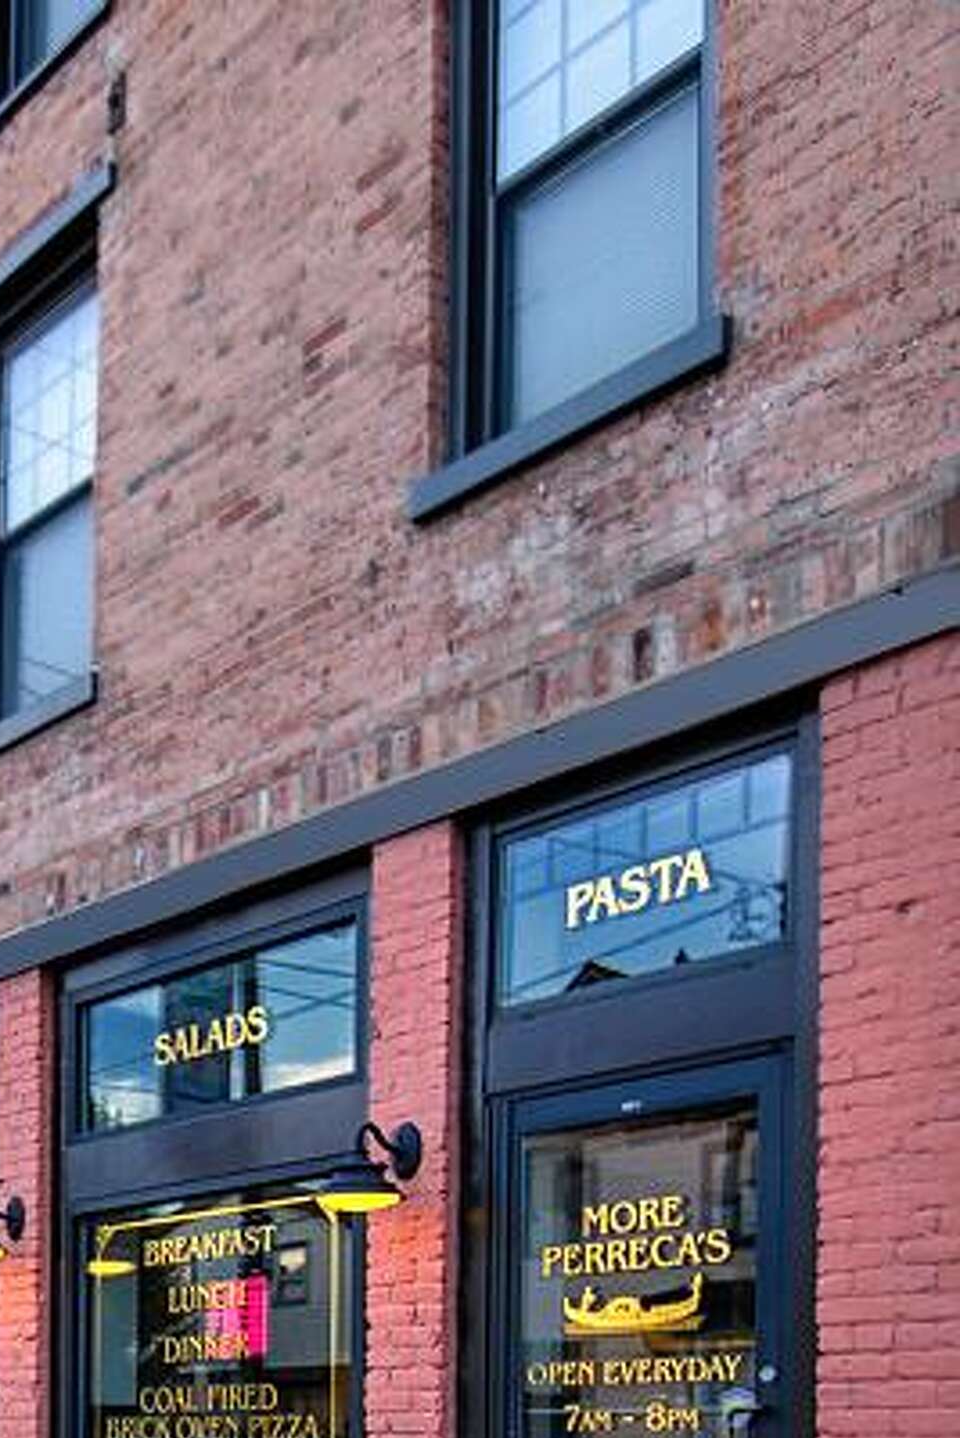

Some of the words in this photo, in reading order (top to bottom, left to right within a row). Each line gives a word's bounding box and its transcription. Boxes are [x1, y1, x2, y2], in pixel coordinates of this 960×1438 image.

[565, 847, 711, 930] PASTA
[154, 1006, 269, 1066] SALADS
[582, 1196, 684, 1237] MORE
[143, 1224, 277, 1266] BREAKFAST
[542, 1229, 732, 1277] PERRECA'S
[167, 1280, 246, 1313] LUNCH
[163, 1332, 249, 1363] DINNER
[527, 1360, 595, 1386] OPEN
[603, 1354, 742, 1386] EVERYDAY
[140, 1385, 197, 1413] COAL
[207, 1383, 279, 1411] FIRED
[563, 1404, 613, 1432] 7AM
[646, 1402, 699, 1432] 8PM
